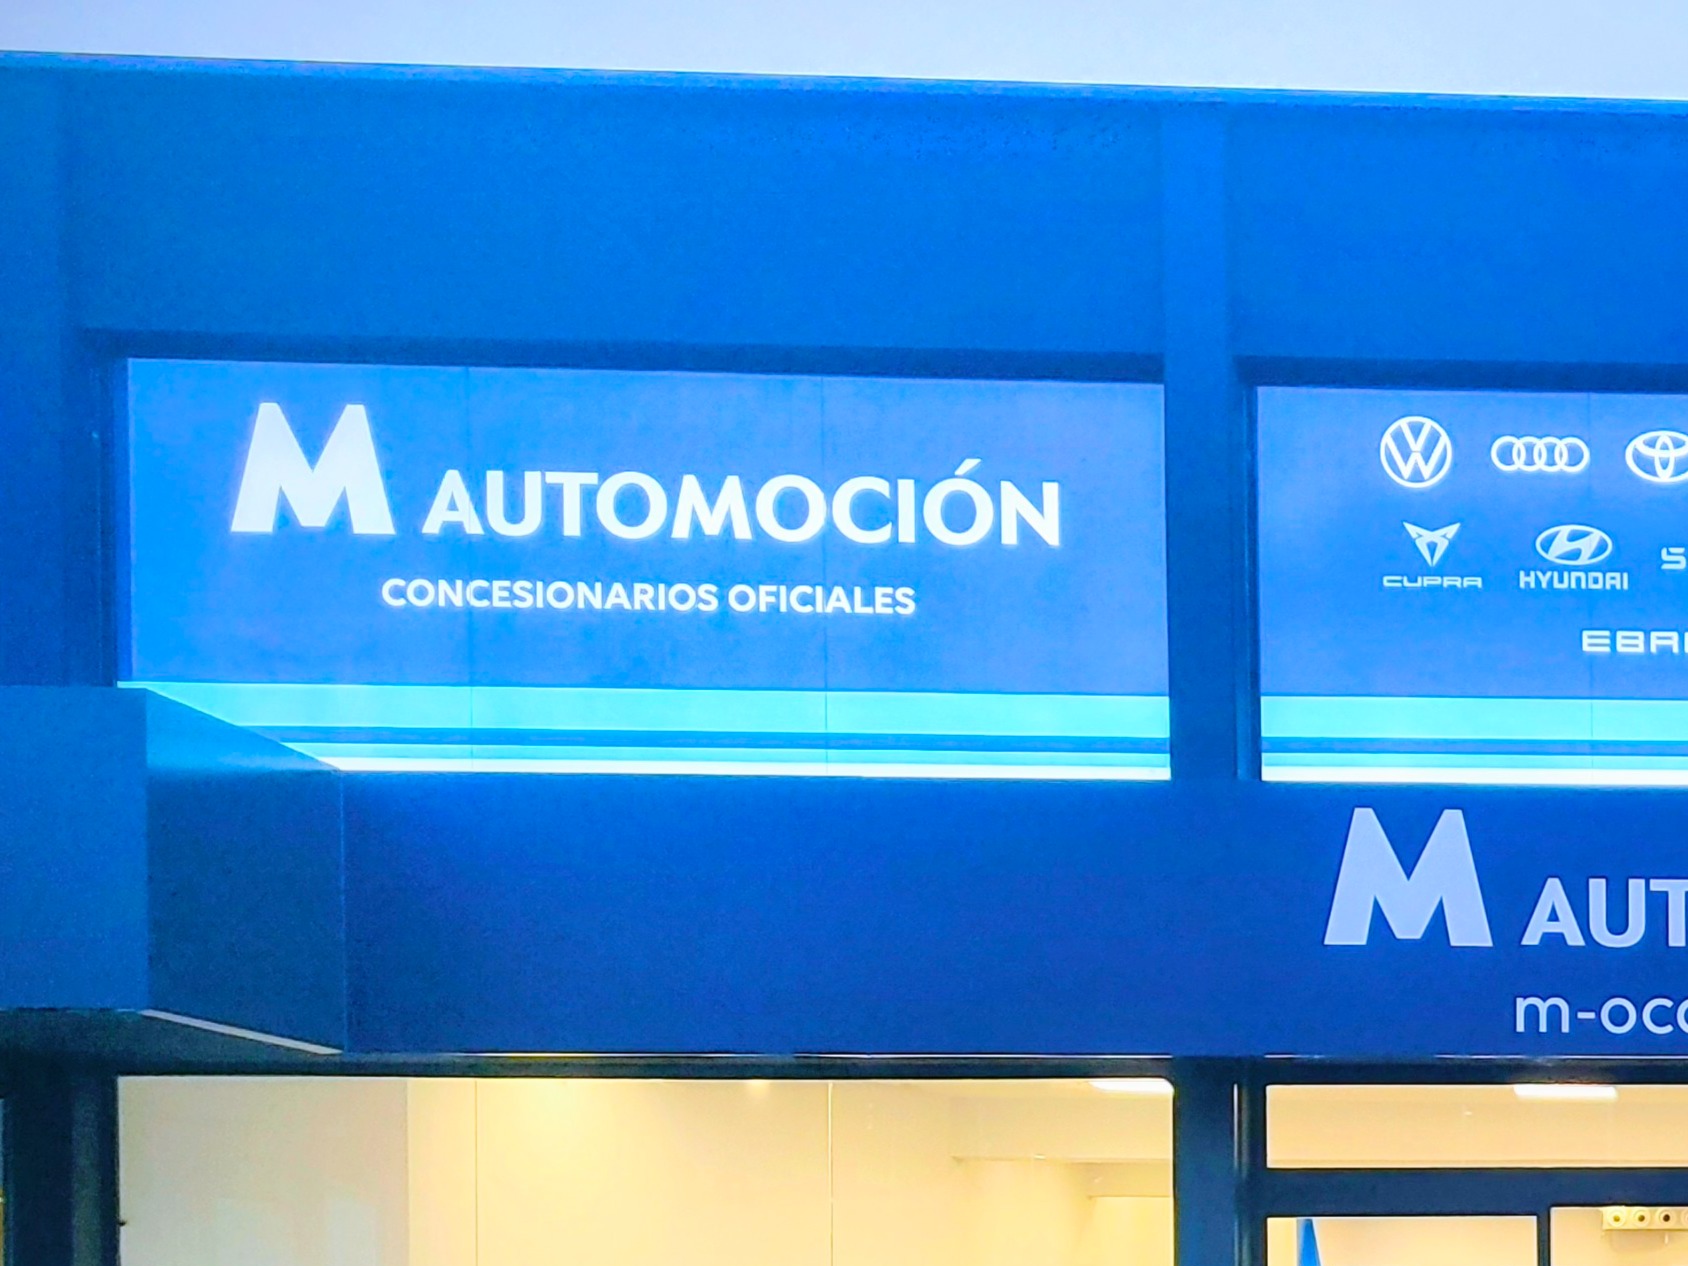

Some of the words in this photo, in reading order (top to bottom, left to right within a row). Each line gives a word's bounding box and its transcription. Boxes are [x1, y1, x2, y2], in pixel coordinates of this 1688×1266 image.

[231, 401, 396, 536] M
[421, 458, 1061, 548] AUTOMOCIÓN
[380, 577, 719, 614] CONCESIONARIOS
[728, 583, 916, 617] OFICIALES
[1382, 575, 1483, 590] CUPRA
[1519, 570, 1629, 591] HYUNDAI
[1323, 807, 1494, 948] M
